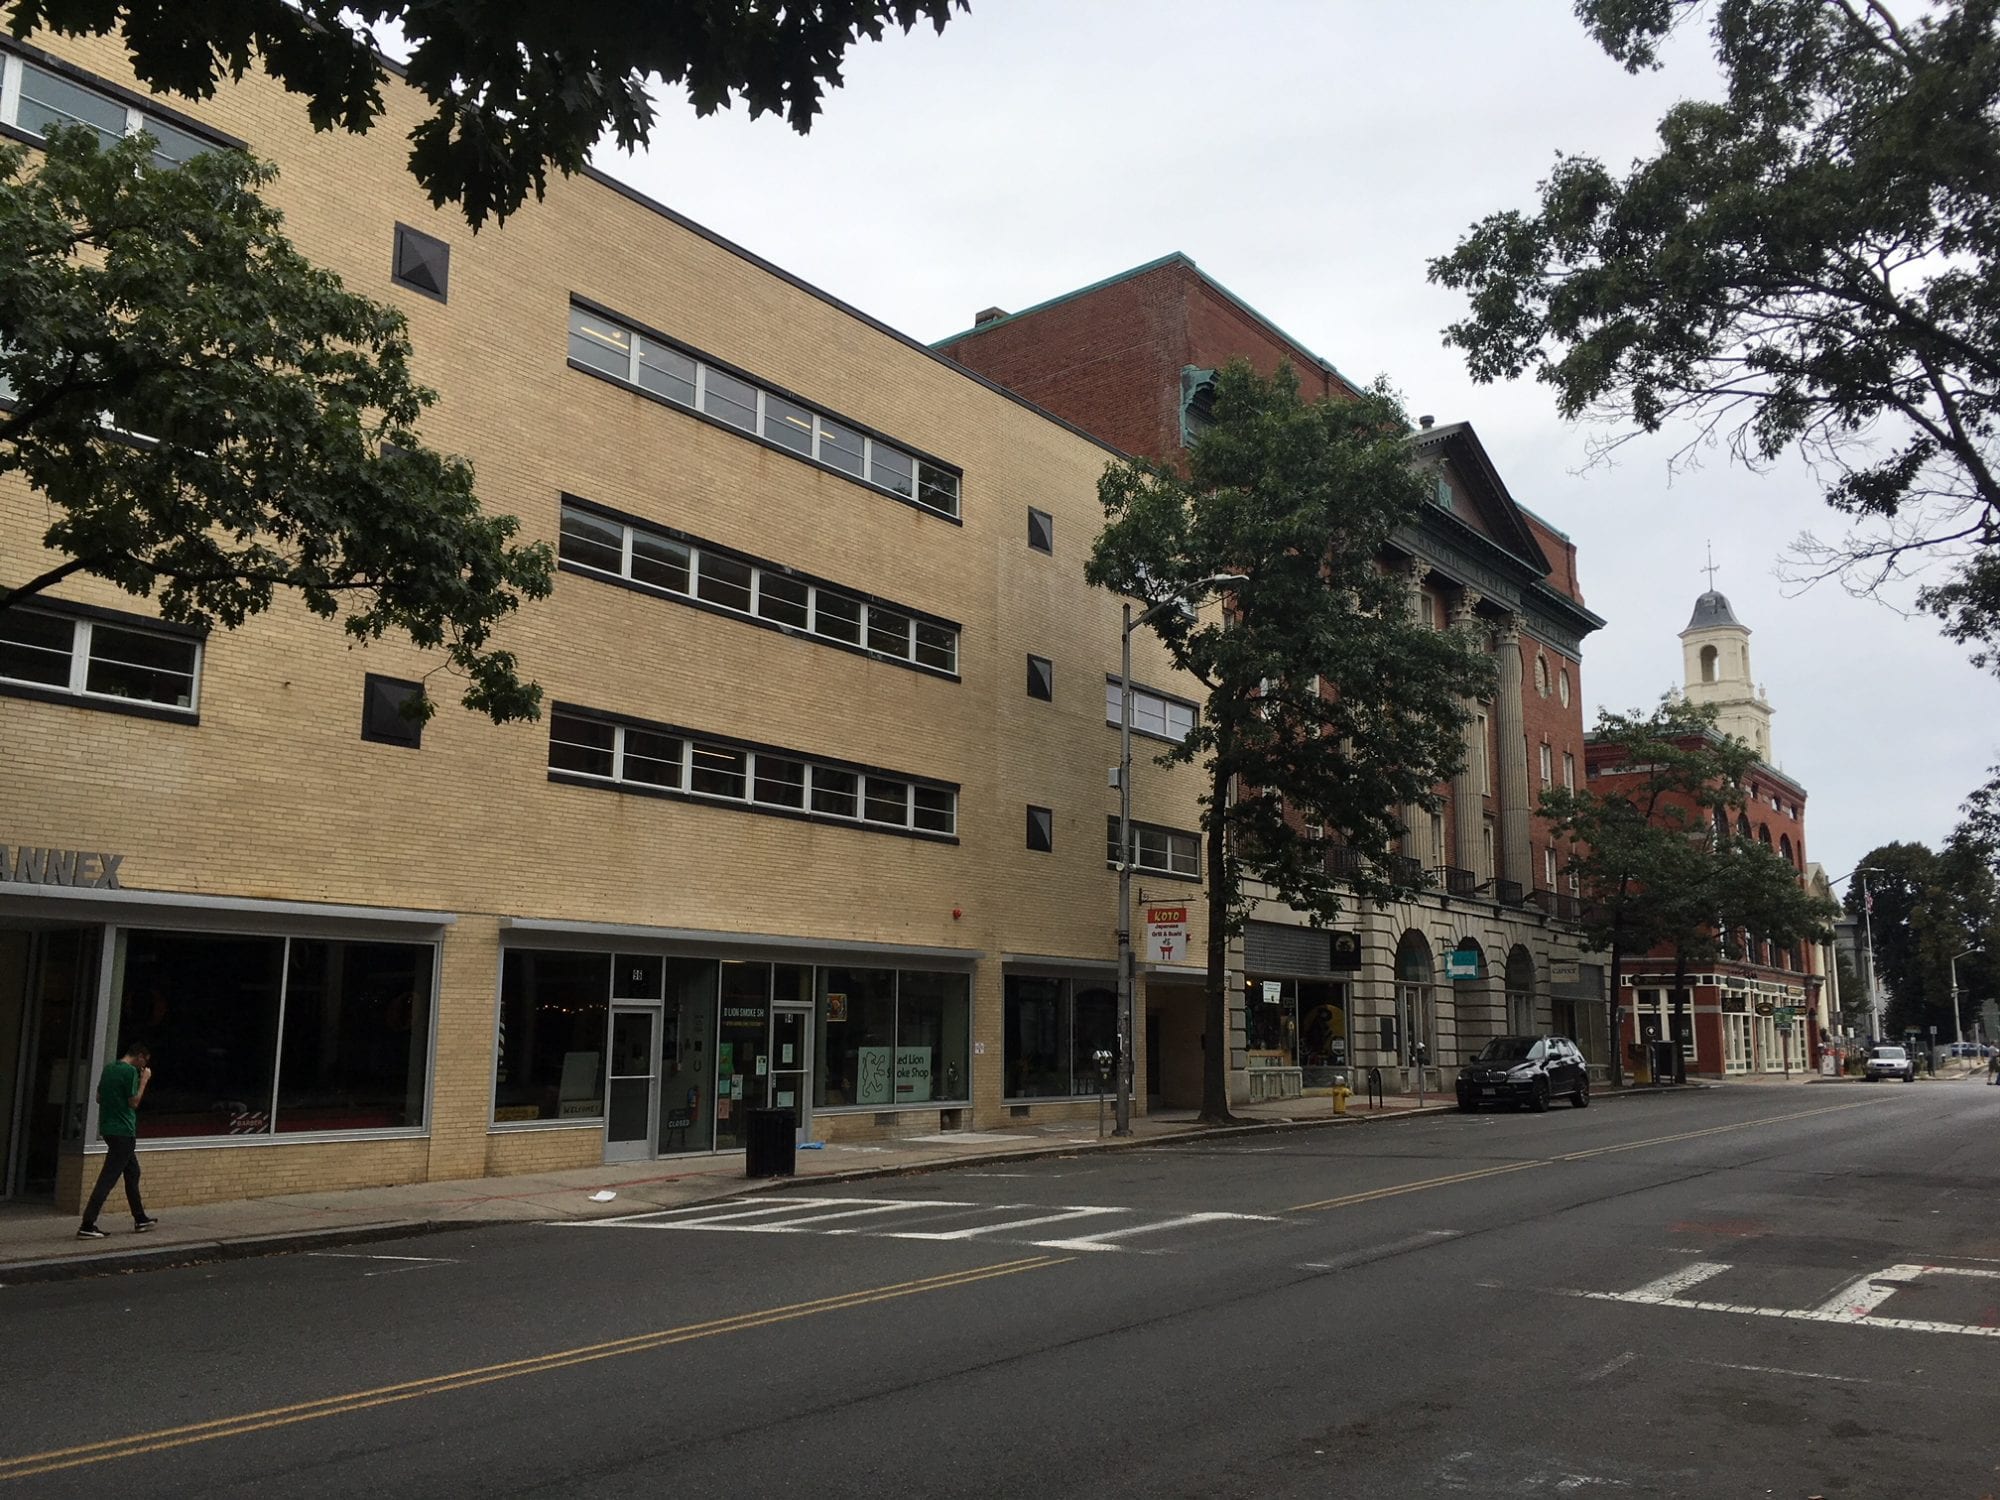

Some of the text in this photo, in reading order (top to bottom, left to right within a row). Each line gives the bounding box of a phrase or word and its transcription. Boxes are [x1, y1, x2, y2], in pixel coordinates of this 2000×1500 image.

[1154, 911, 1180, 921] KOTO
[909, 1054, 924, 1065] Lion
[887, 1067, 929, 1080] Soke Shop
